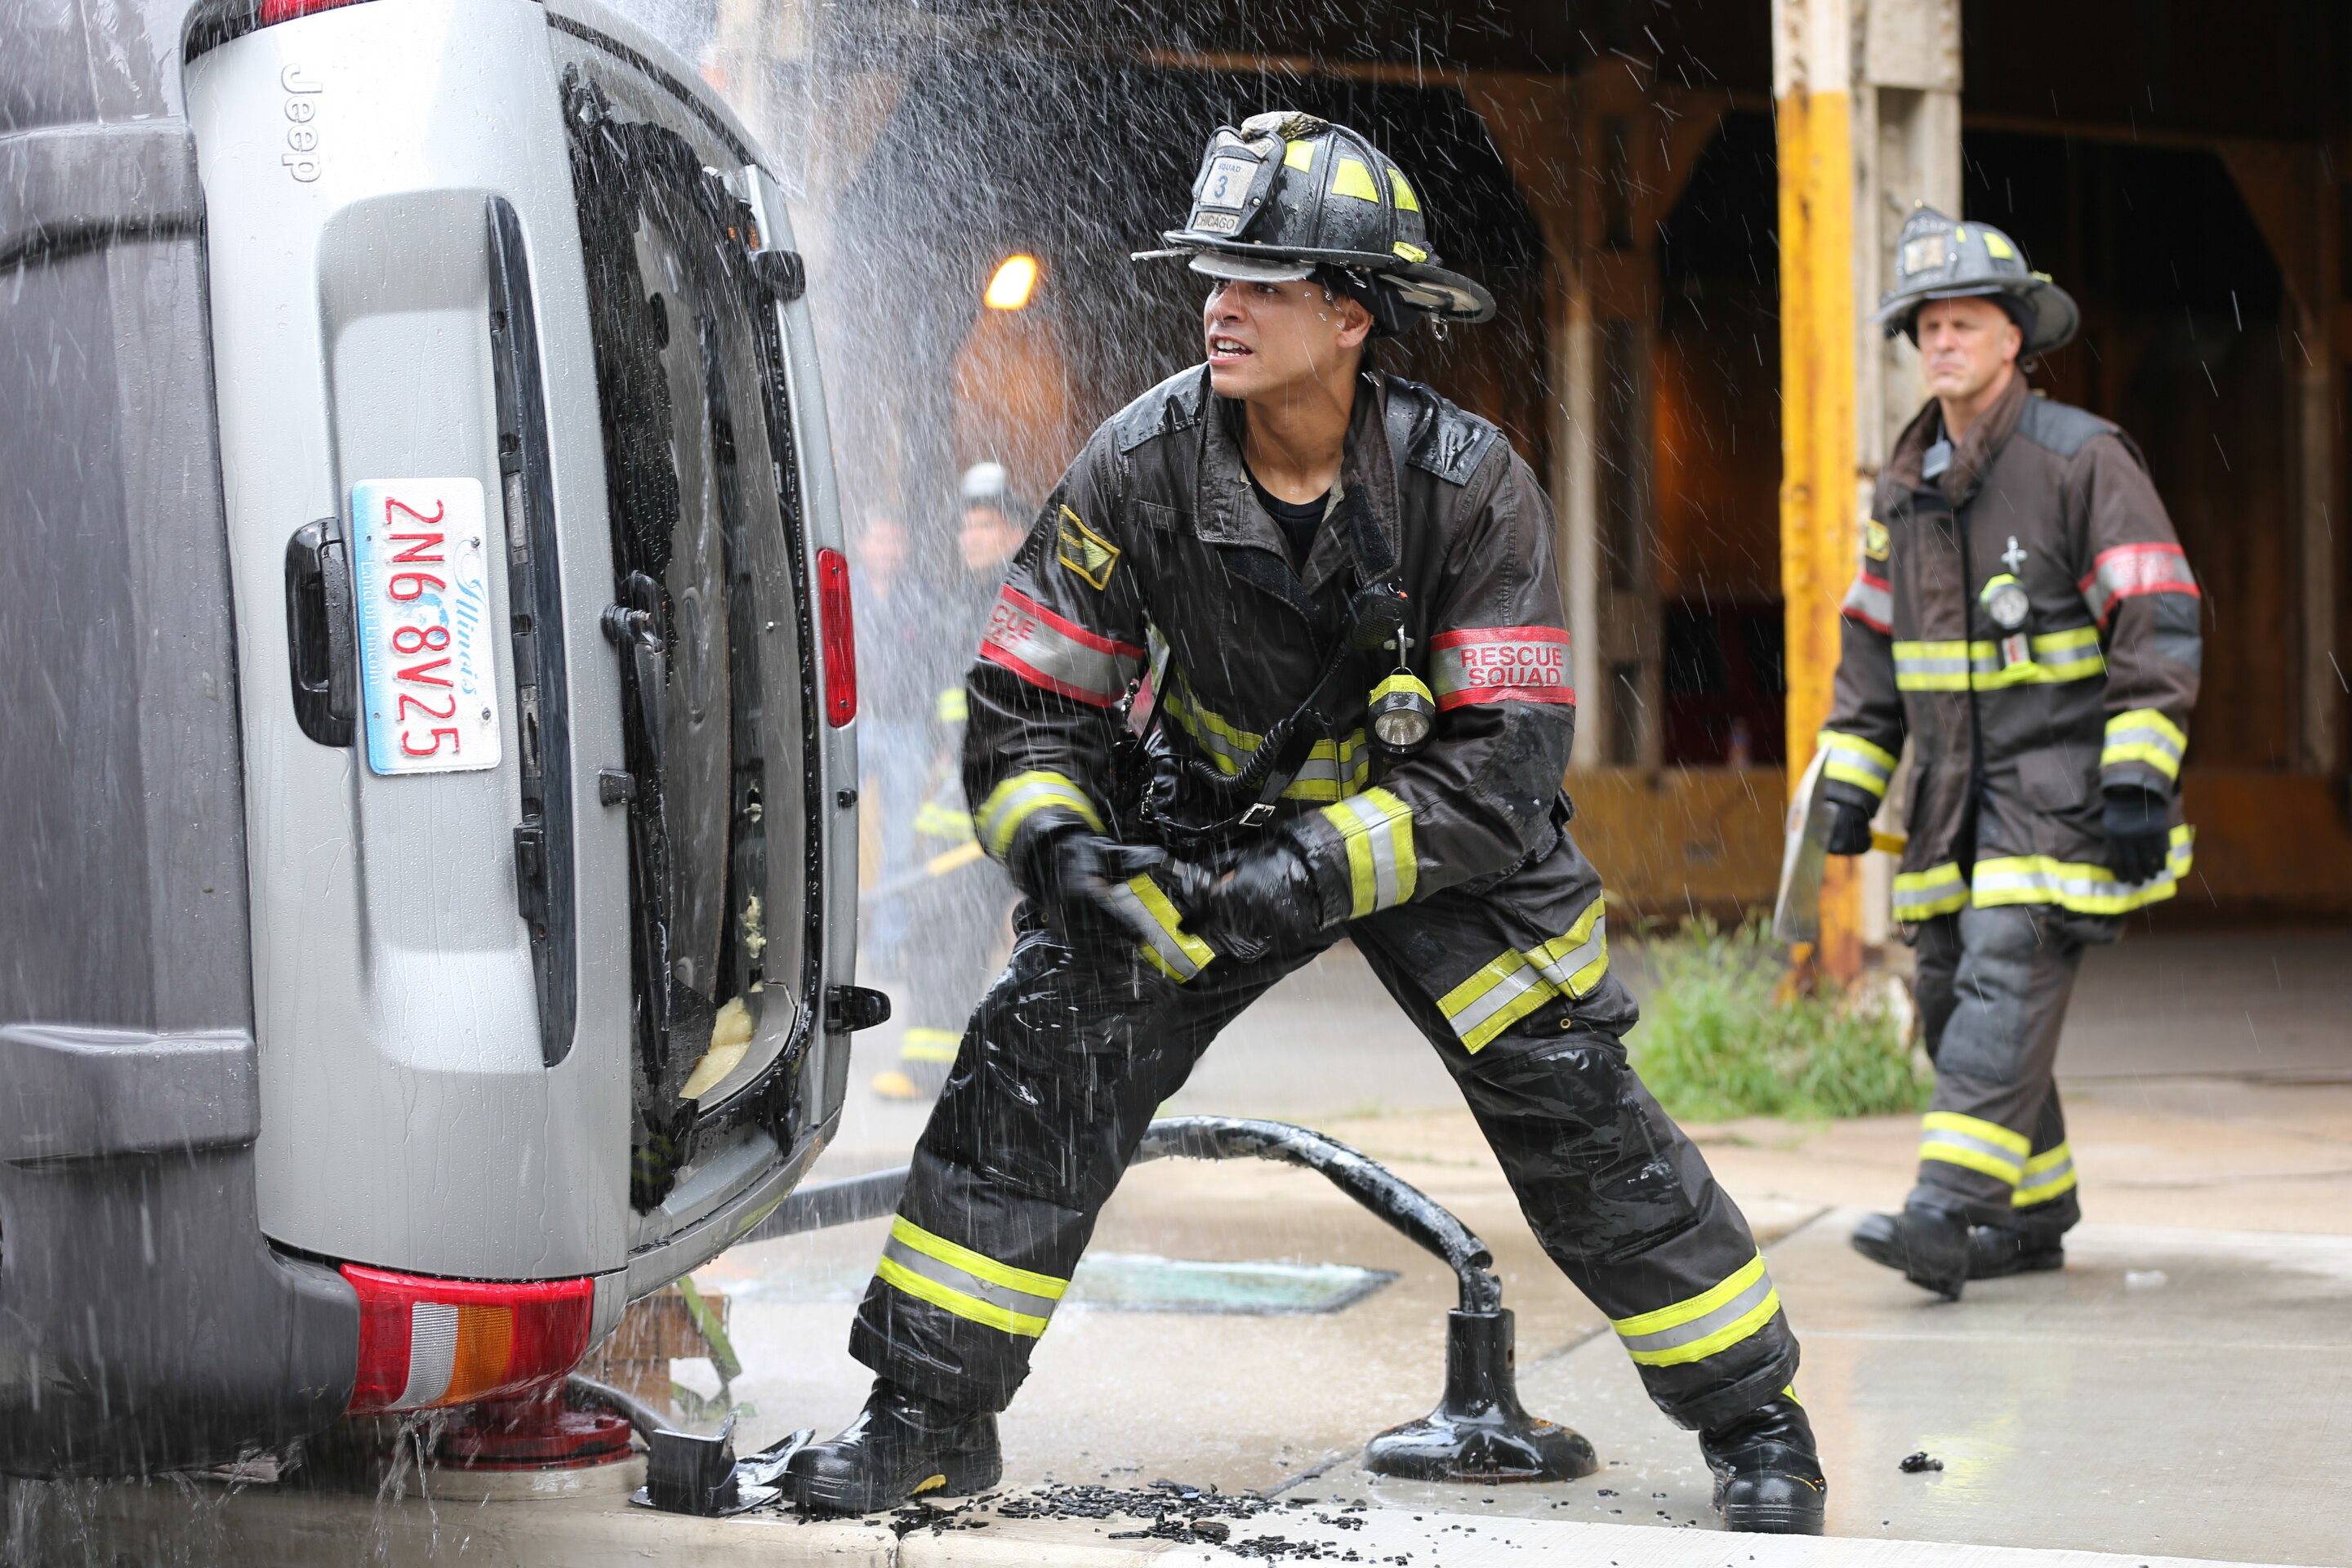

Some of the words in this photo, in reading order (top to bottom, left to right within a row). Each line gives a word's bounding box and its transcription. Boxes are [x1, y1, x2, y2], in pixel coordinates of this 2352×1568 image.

[281, 63, 323, 183] Jeep
[1218, 163, 1241, 173] SQUAD
[1214, 175, 1228, 198] 3
[1196, 214, 1236, 229] CHICAGO
[361, 561, 378, 600] Land
[364, 604, 378, 620] of
[453, 539, 488, 695] Illinois
[991, 604, 1037, 641] CUE
[366, 626, 384, 686] Lincoln
[1461, 646, 1564, 668] RESCUE
[1468, 666, 1561, 687] SQUAD
